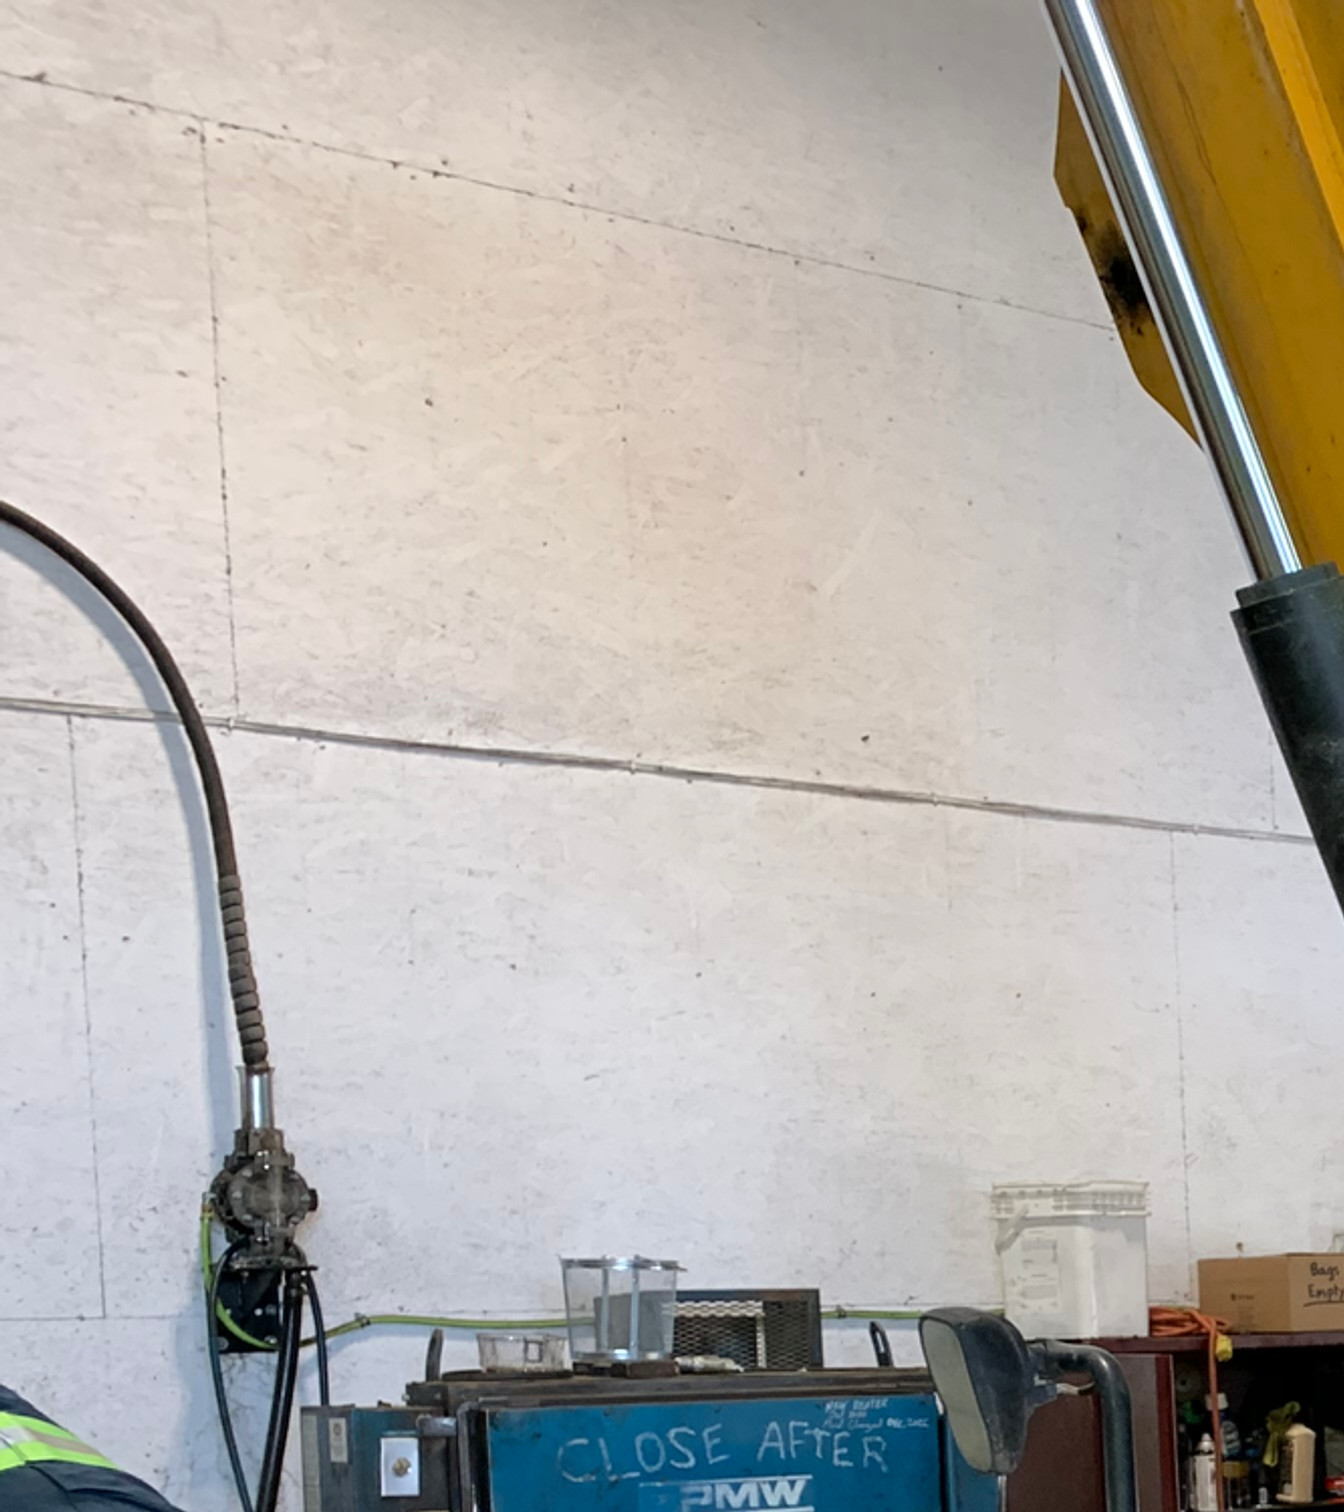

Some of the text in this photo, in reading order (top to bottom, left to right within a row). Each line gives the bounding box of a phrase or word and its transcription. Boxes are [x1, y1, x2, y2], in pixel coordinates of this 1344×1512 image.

[1309, 1261, 1340, 1283] Bags
[556, 1420, 889, 1484] CLOSE AFTER
